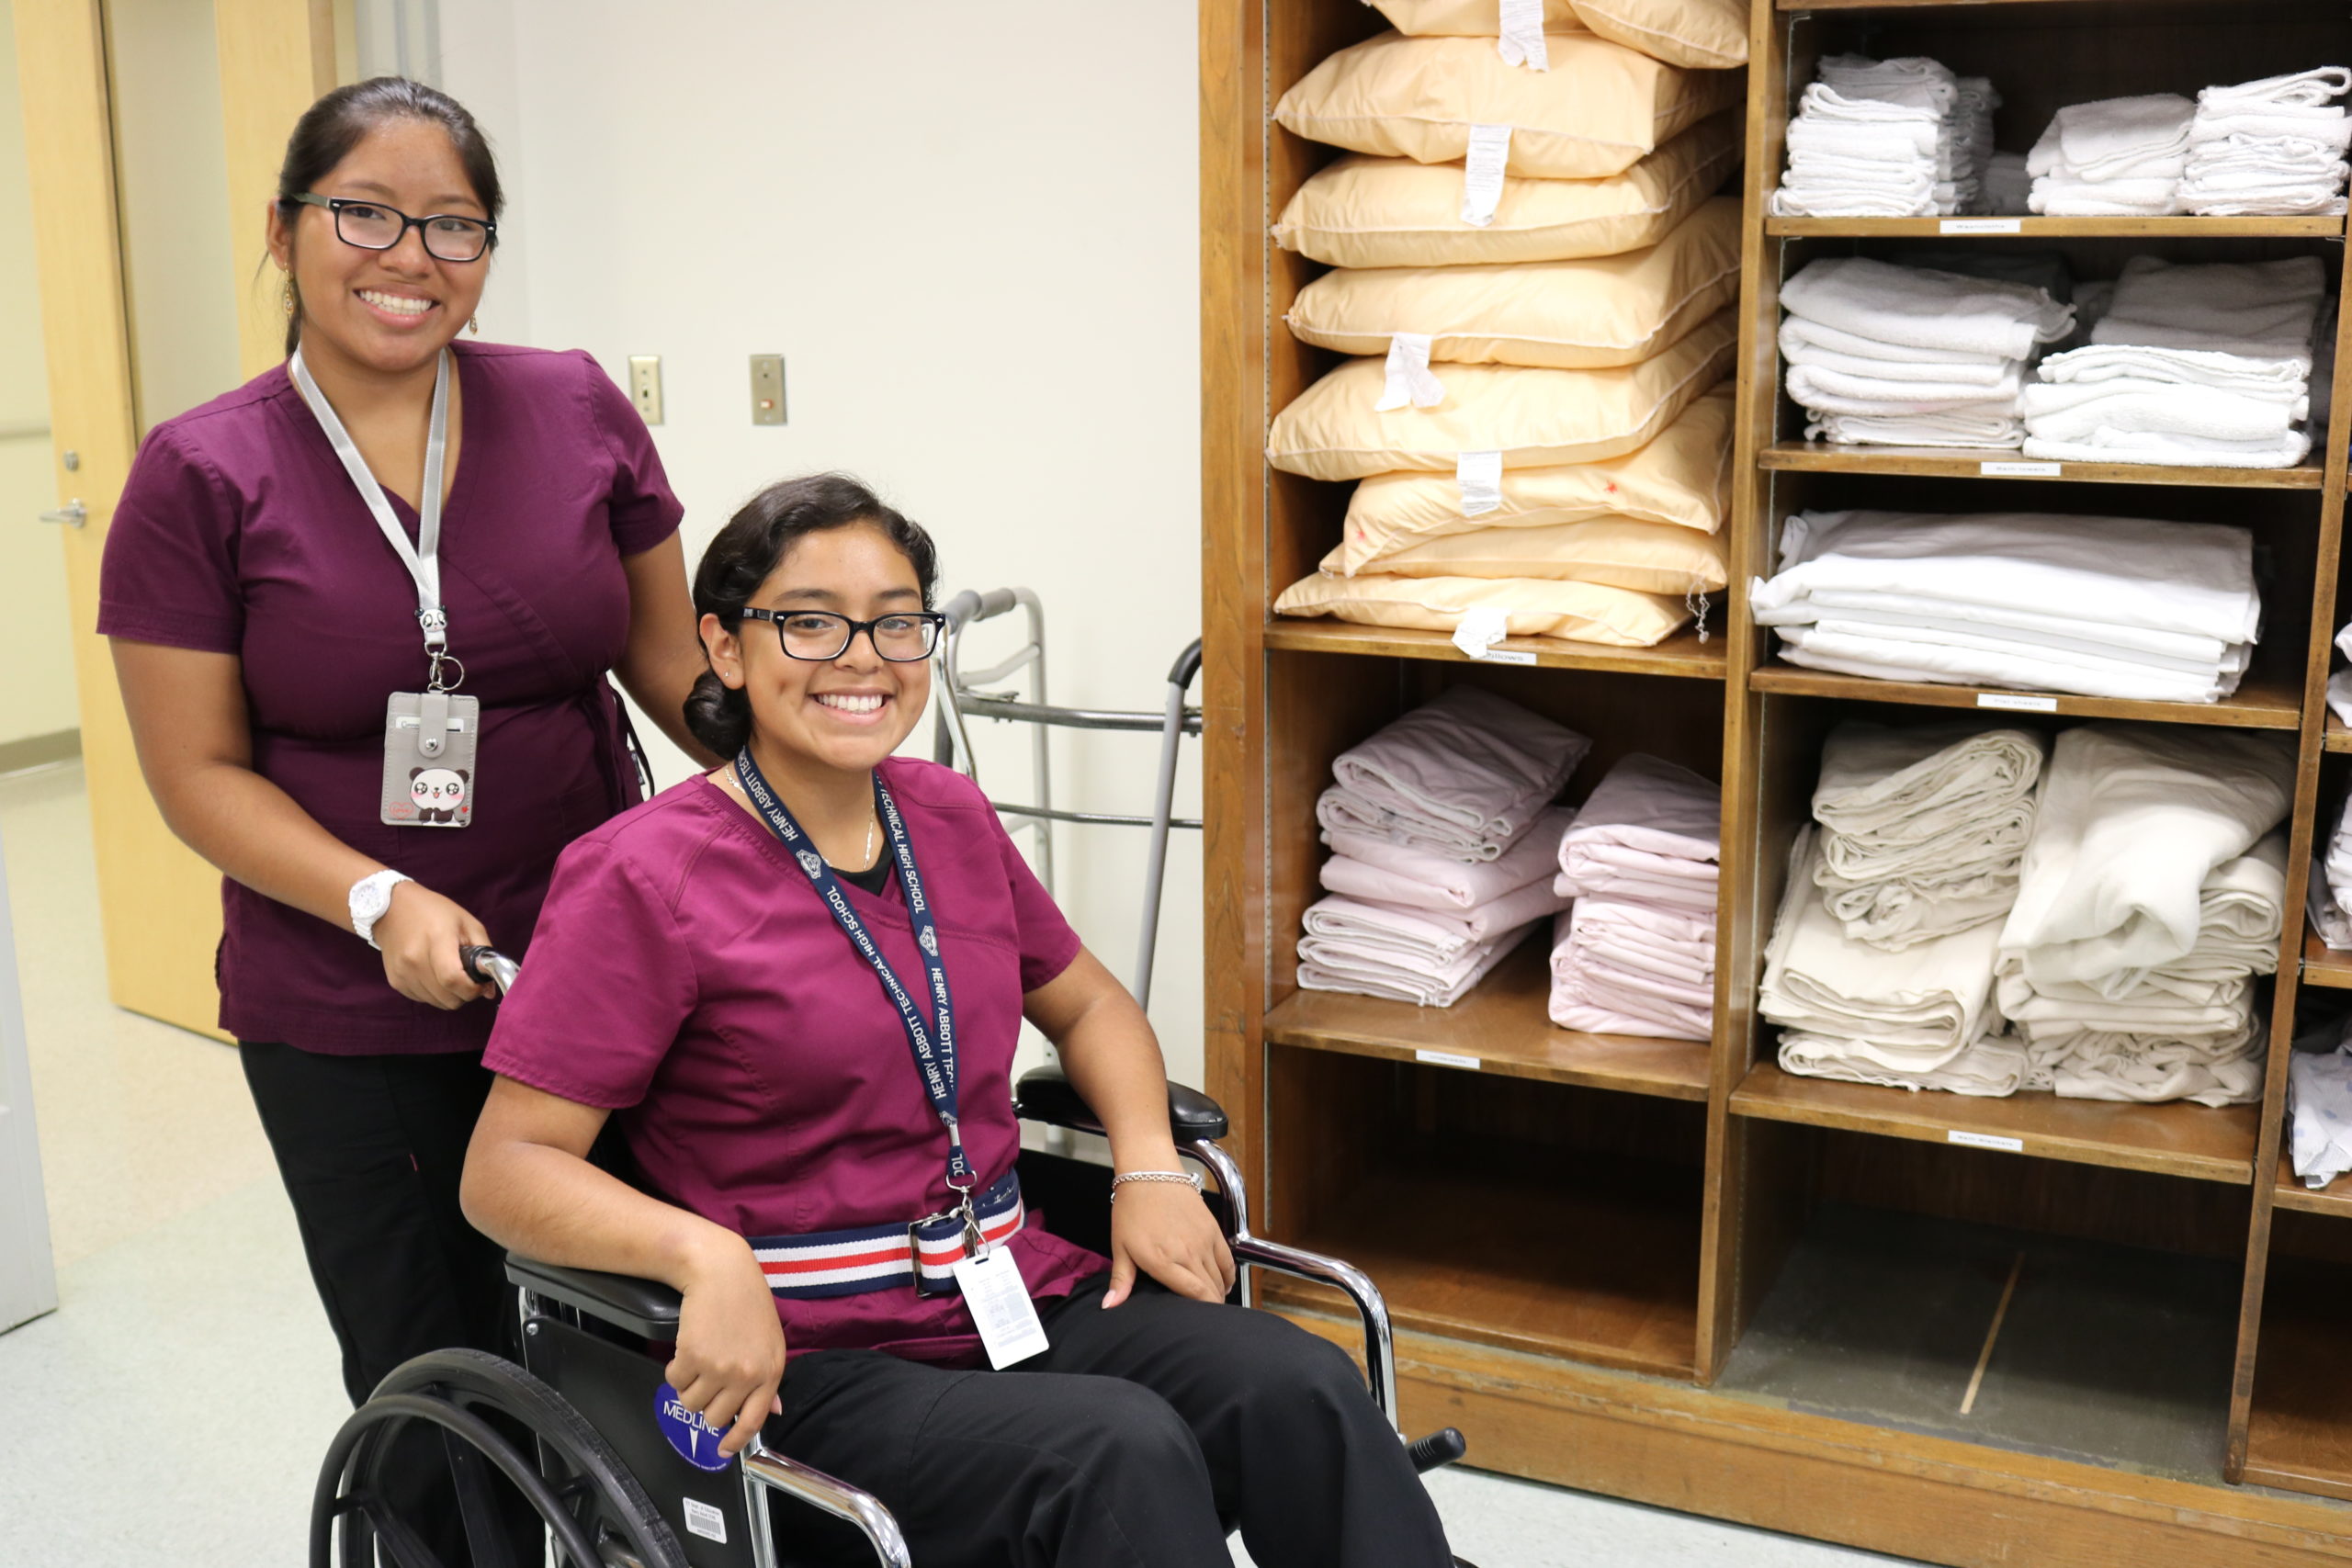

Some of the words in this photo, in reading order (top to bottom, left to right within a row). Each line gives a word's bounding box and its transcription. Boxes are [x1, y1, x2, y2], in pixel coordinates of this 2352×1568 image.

[745, 773, 775, 809] ABBOTT
[767, 808, 798, 841] HENRY
[898, 844, 914, 869] HIGH
[827, 886, 858, 931] SCHOOL
[905, 870, 925, 914] SCHOOL
[854, 930, 876, 956] HIGH
[874, 955, 912, 1015] TECHNICAL
[932, 967, 948, 1006] HENRY
[908, 1015, 933, 1059] ABBOTT
[938, 1007, 953, 1055] ABBOTT
[924, 1061, 947, 1100] HENRY
[663, 1400, 719, 1438] MEDLINE
